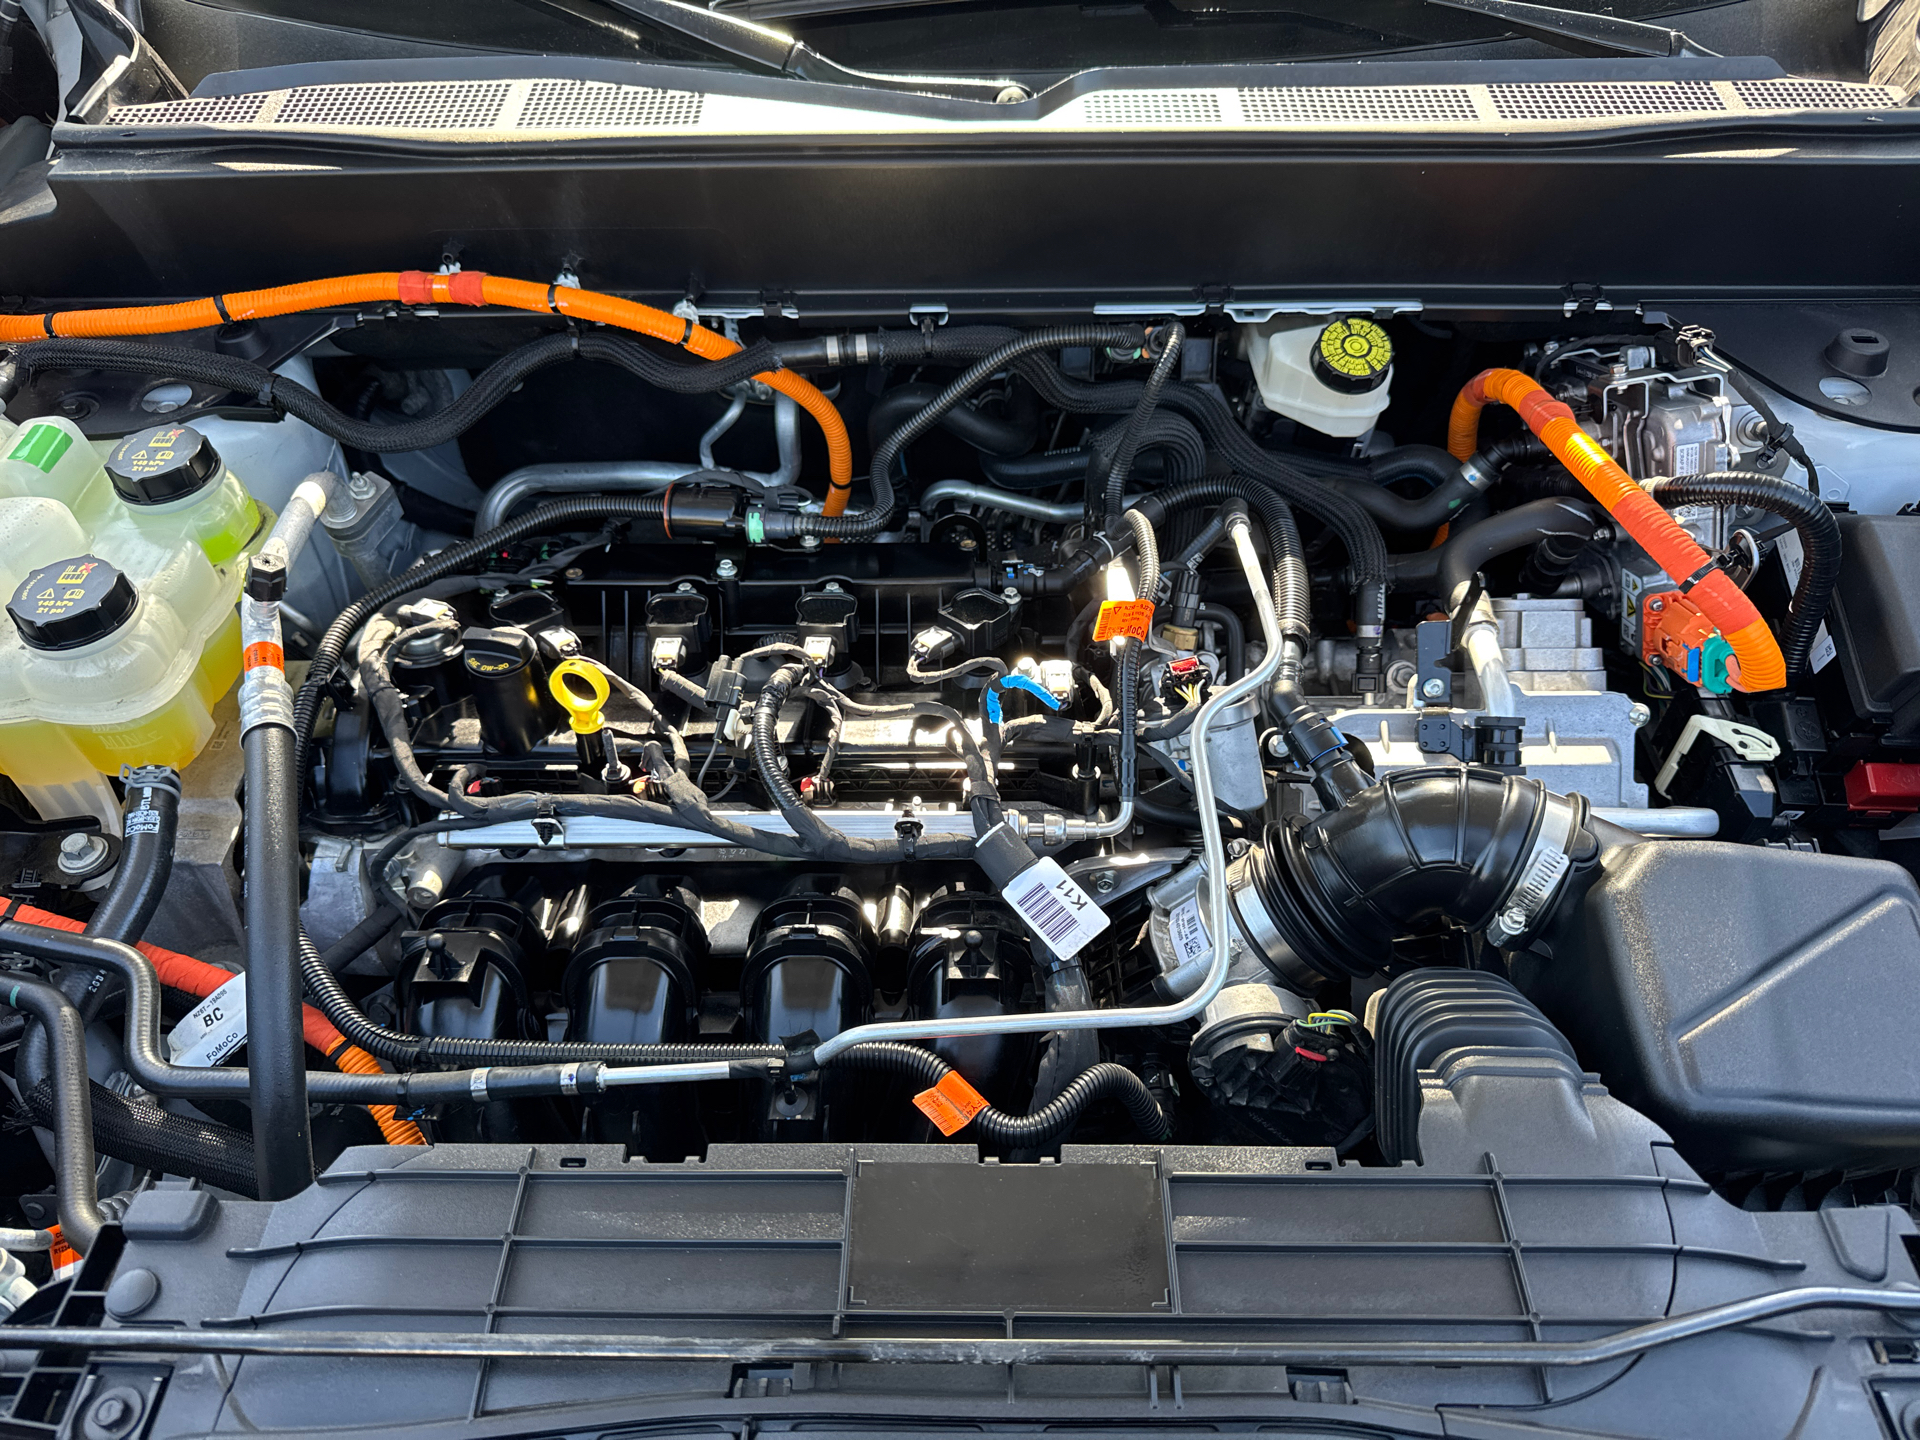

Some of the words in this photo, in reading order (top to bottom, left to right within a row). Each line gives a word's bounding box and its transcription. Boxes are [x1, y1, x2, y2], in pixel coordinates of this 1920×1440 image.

[49, 607, 65, 615] psi
[468, 657, 481, 669] SAE
[480, 662, 510, 672] 0W-20
[127, 823, 158, 833] FoMoCo
[1055, 879, 1088, 911] K11
[202, 1006, 224, 1028] BC
[205, 1032, 239, 1062] FoMoCo
